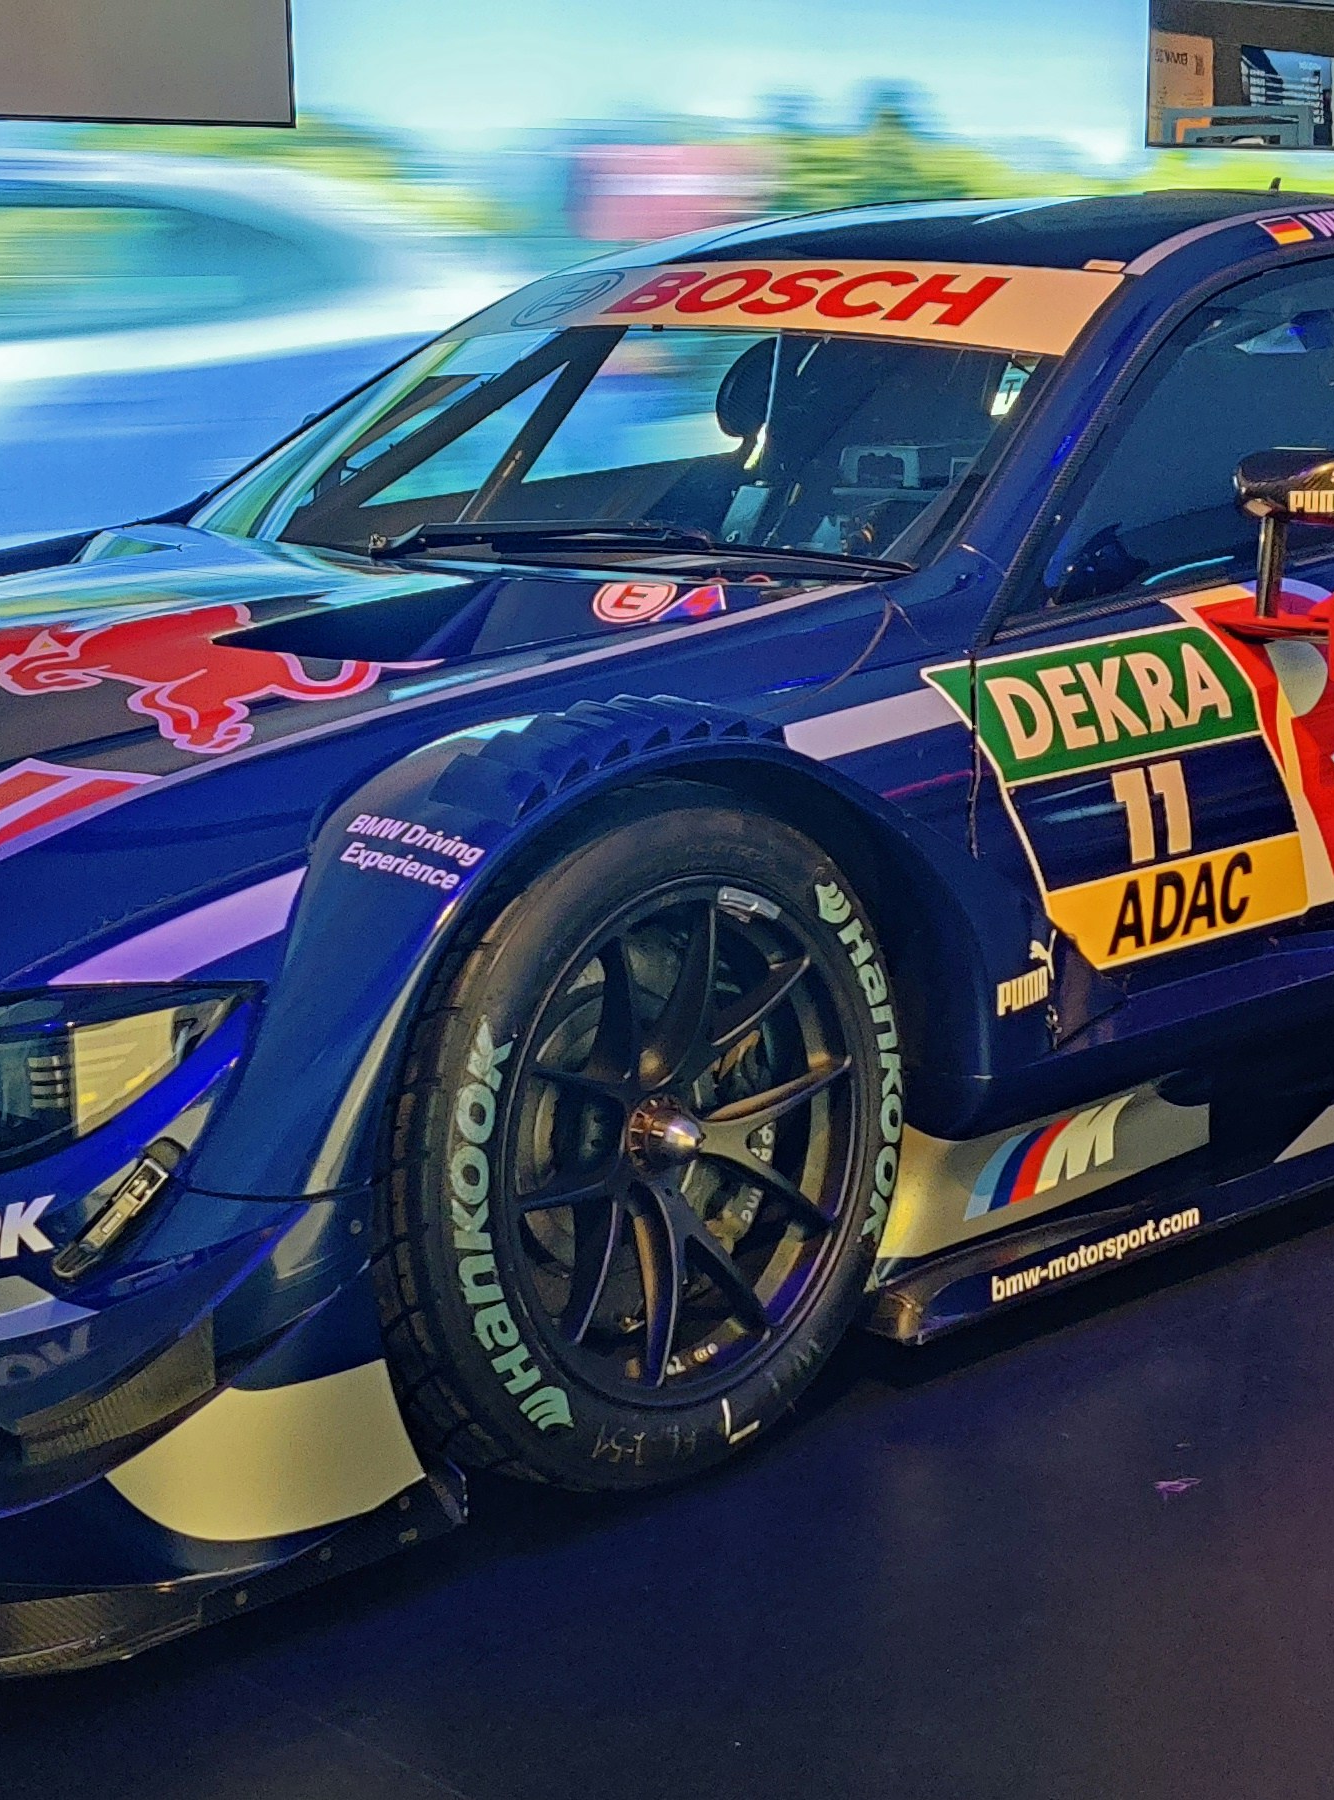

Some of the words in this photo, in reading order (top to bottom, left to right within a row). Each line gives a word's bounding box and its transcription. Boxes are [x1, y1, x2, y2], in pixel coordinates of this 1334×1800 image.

[599, 269, 1012, 327] BOSCH
[985, 643, 1233, 760] DEKRA
[346, 813, 411, 841] BMW
[401, 825, 485, 867] Driving
[1111, 760, 1193, 864] 11
[340, 842, 460, 890] Experience
[1108, 851, 1252, 955] ADAC
[996, 965, 1049, 1017] PUMA
[992, 1207, 1201, 1302] bmw-motorsport.com
